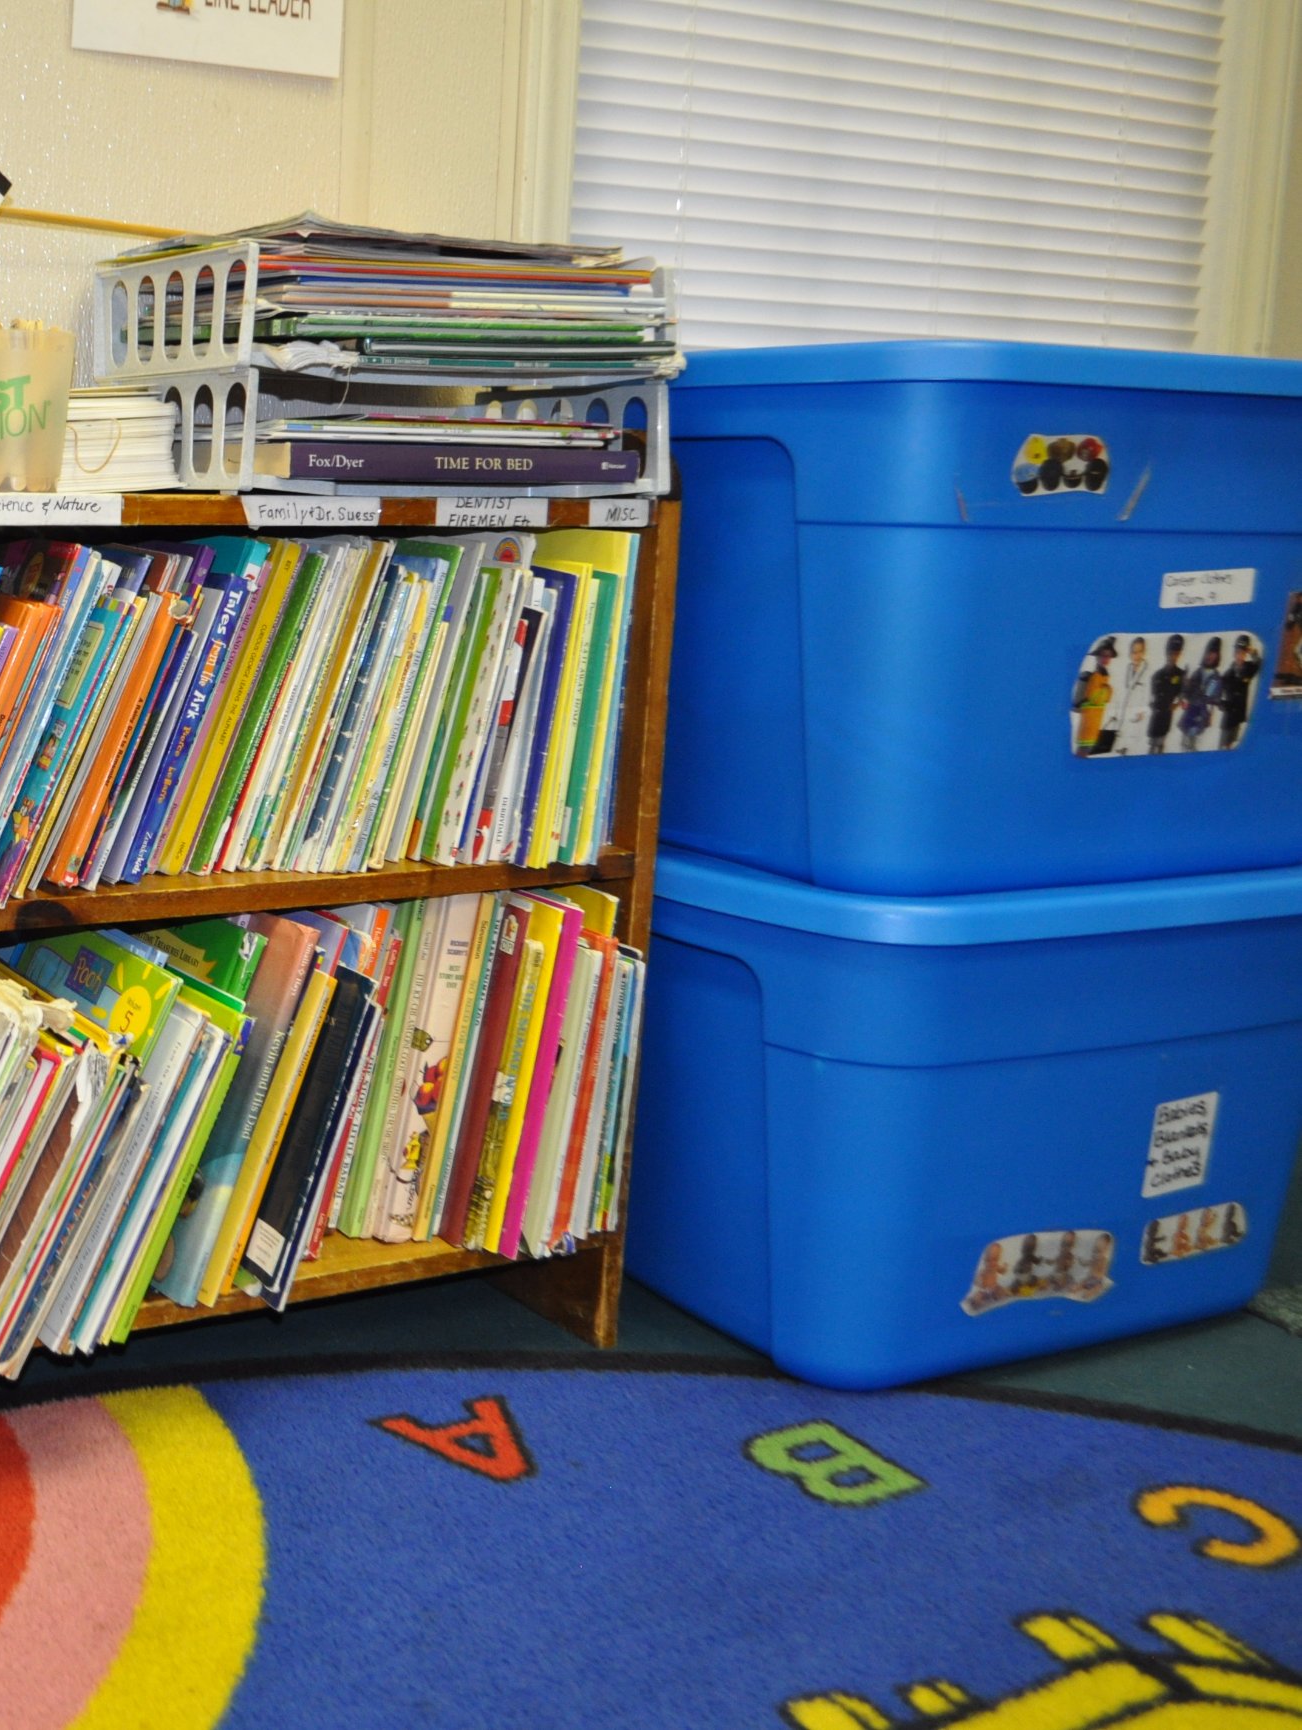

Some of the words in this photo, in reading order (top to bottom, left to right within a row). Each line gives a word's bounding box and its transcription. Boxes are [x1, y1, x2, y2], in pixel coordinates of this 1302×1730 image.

[308, 453, 365, 470] Fox/Dyer
[434, 456, 469, 471] TIME
[475, 456, 502, 471] FOR
[506, 457, 533, 472] BED
[53, 495, 102, 513] Nature
[258, 502, 304, 525] Family
[338, 506, 376, 521] Suess
[455, 497, 515, 509] DENTIST
[448, 514, 507, 527] FIREMEN
[283, 559, 291, 571] REY
[215, 587, 243, 637] Tales
[251, 623, 267, 651] CURIOUS
[203, 637, 227, 668] from
[242, 651, 256, 678] GEORGE
[411, 649, 423, 666] THE
[197, 669, 215, 689] the
[233, 678, 247, 702] LEARNS
[396, 668, 417, 715] SNOWMAN
[127, 703, 141, 724] Rainy
[185, 689, 207, 721] Ark
[229, 703, 238, 715] THE
[121, 724, 133, 740] Day
[218, 716, 233, 746] ALPHABET
[380, 716, 402, 769] STORYBOOK
[103, 748, 124, 788] Remember
[493, 796, 509, 844] DERRYDALE
[473, 919, 488, 960] Stevenson
[299, 942, 314, 968] Smalls
[74, 955, 103, 994] Pooh
[289, 977, 302, 997] Hays
[119, 1011, 134, 1033] 5
[265, 1029, 286, 1064] Kevin
[257, 1066, 273, 1090] and
[249, 1091, 265, 1113] His
[240, 1113, 257, 1140] Dad
[344, 1122, 358, 1157] LITTLE
[1162, 1147, 1200, 1166] Baby
[334, 1161, 349, 1199] BABAJI
[370, 1396, 536, 1482] A
[744, 1419, 928, 1508] B
[1135, 1484, 1301, 1567] C
